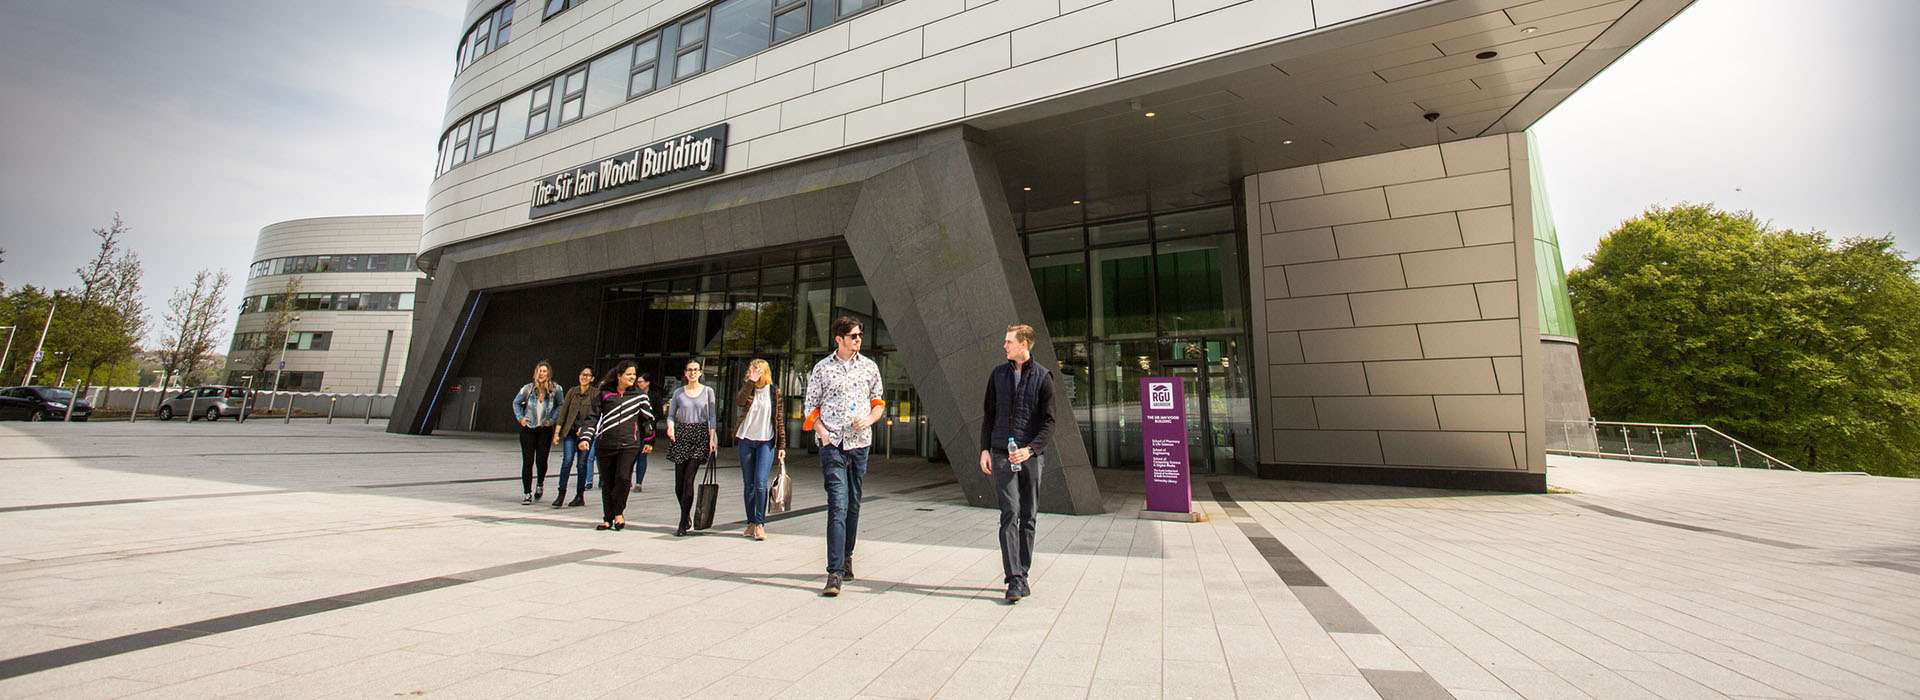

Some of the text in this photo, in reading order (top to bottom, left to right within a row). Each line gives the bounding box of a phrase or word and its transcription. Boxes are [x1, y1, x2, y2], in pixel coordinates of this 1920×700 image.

[531, 135, 714, 208] The Sir Ian Wood Building
[1152, 392, 1171, 402] RGU
